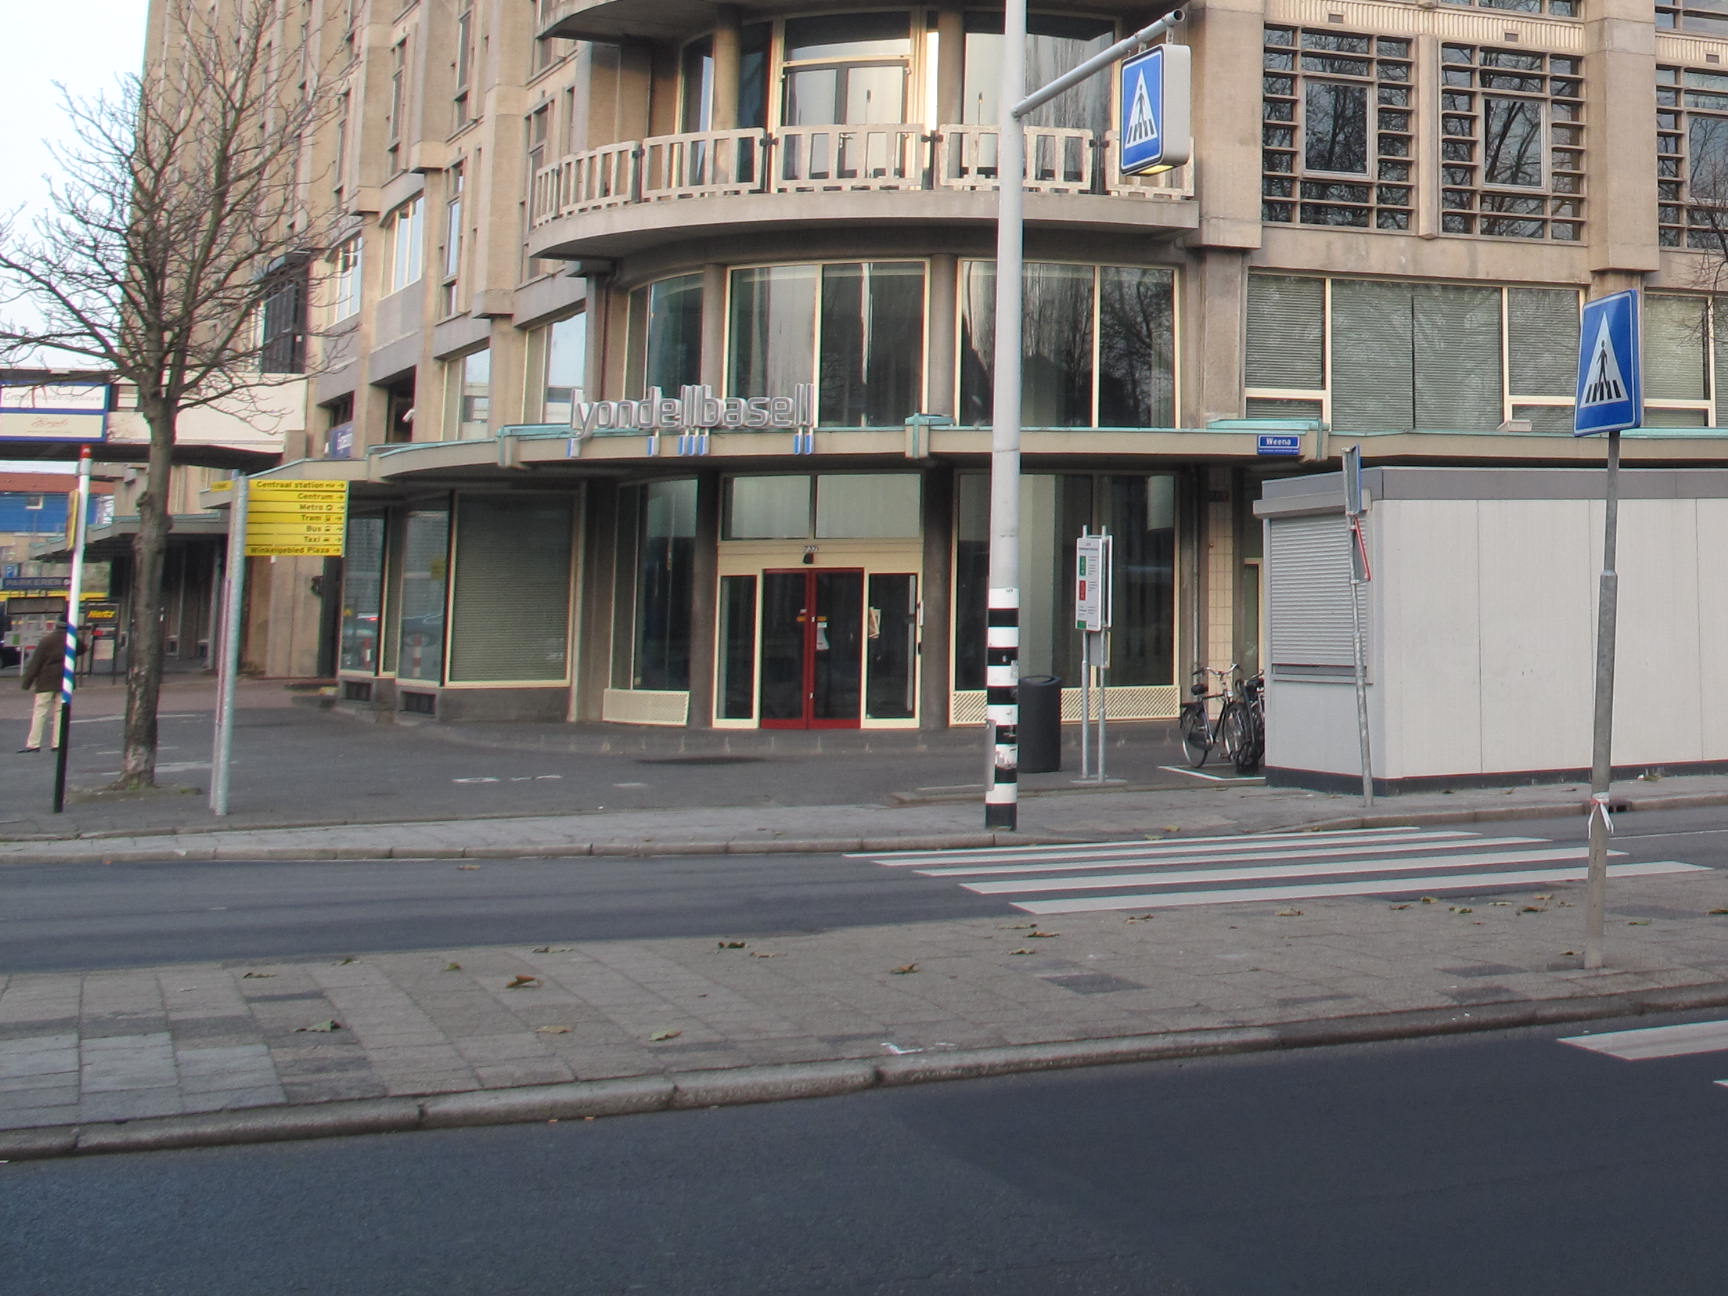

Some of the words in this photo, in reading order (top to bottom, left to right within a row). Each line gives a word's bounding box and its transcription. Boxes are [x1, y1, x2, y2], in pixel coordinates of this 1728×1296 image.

[570, 383, 815, 446] lyondellbasell
[1266, 437, 1291, 446] Weena
[256, 480, 292, 489] Centraal
[294, 481, 324, 489] station
[297, 492, 334, 500] Centrum
[299, 503, 323, 511] Metro
[301, 514, 322, 522] Tram
[306, 525, 322, 533] Bus
[303, 535, 321, 543] Taxi
[250, 546, 305, 556] Winkelgebied
[307, 546, 330, 554] Plaza
